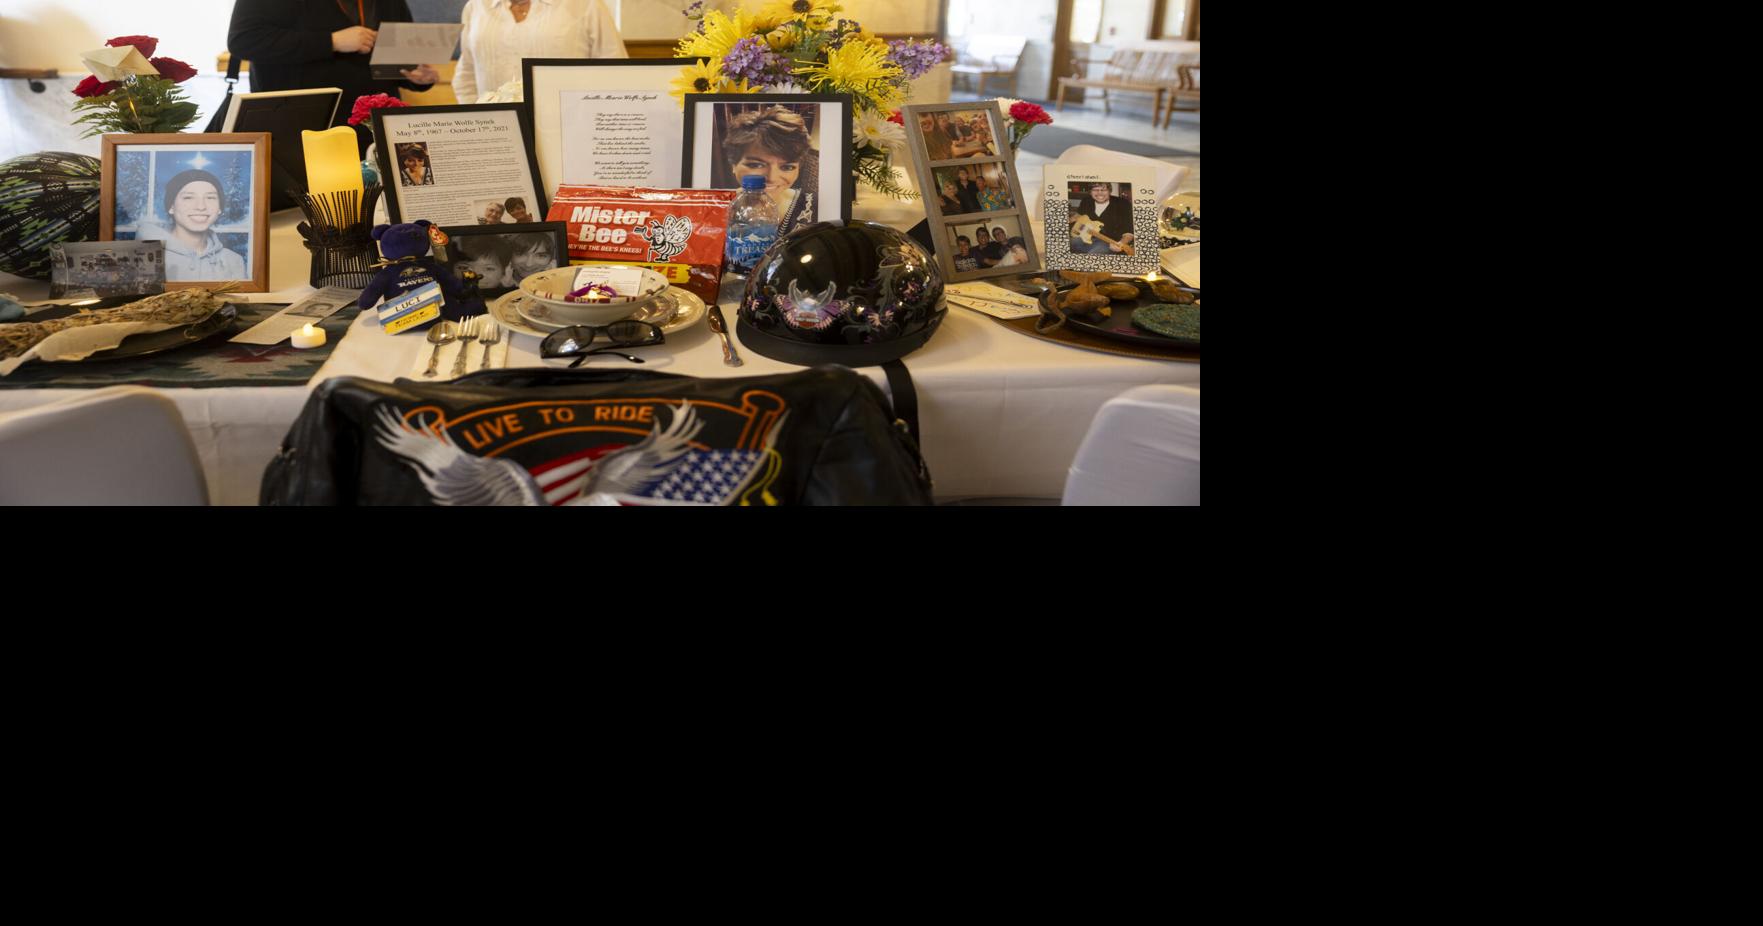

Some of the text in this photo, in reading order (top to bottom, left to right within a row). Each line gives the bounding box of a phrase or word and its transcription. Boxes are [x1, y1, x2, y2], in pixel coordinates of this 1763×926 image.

[570, 206, 651, 226] Mister
[578, 224, 627, 244] Bee
[619, 246, 642, 254] KNEES!
[463, 405, 655, 449] LIVE TO RIDE
